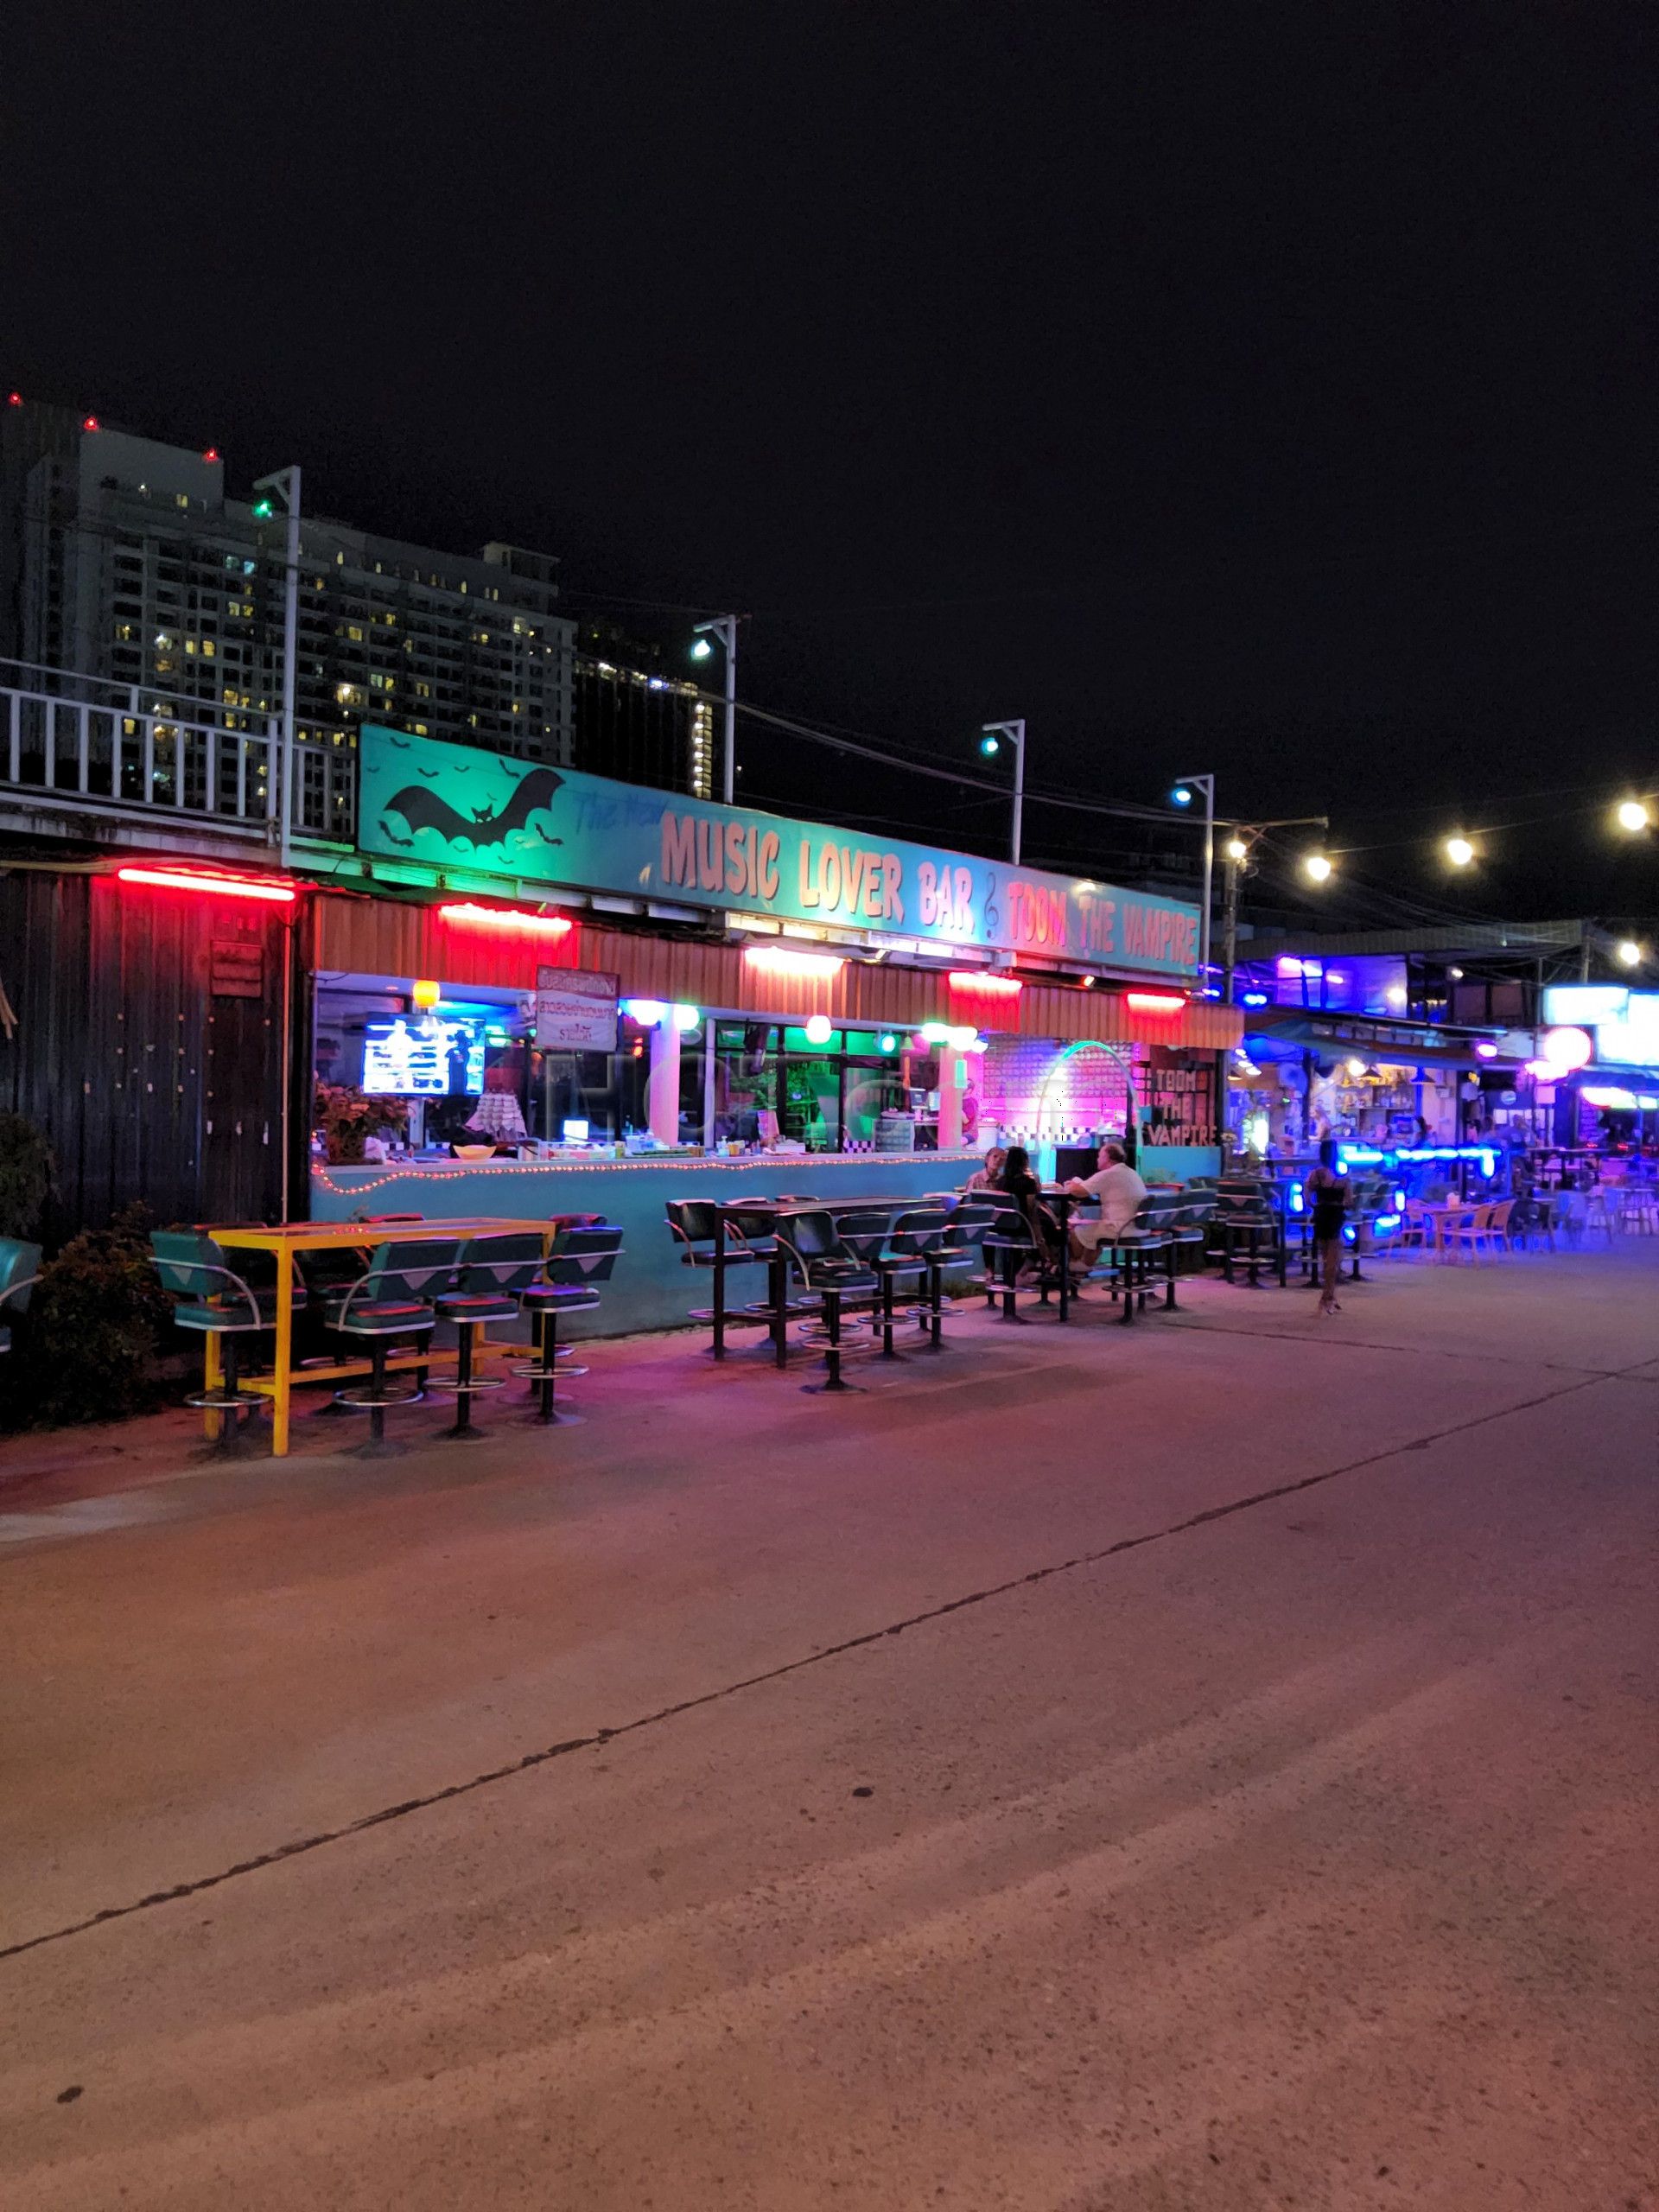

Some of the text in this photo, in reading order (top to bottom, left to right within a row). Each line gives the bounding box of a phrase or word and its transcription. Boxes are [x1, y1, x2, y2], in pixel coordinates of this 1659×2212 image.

[661, 813, 1197, 964] MUSIC LOVER BAR TOOM THE VAMPIRE
[1157, 1070, 1195, 1091] TOOM
[1163, 1097, 1192, 1120] THE
[1147, 1126, 1216, 1147] VAMPIRE
